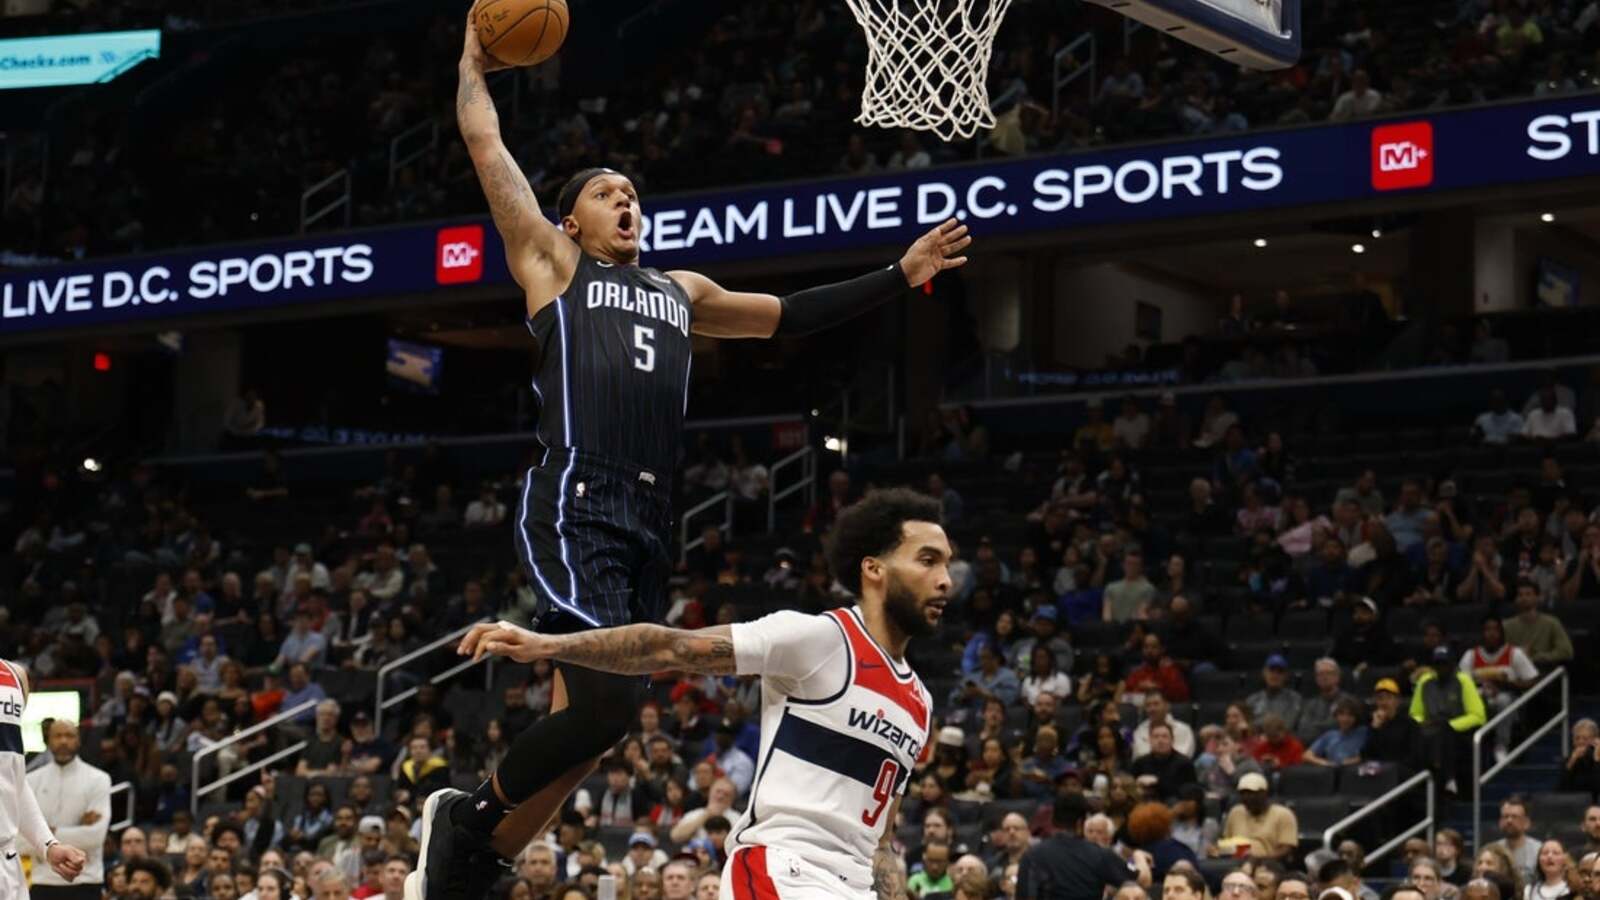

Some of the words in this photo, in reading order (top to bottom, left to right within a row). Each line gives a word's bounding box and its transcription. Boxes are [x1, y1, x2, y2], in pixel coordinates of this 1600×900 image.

[1527, 110, 1600, 160] ST
[783, 187, 902, 237] LIVE
[917, 176, 1018, 224] D.C.
[1033, 147, 1283, 212] SPORTS
[3, 274, 94, 318] LIVE
[102, 266, 179, 308] D.C.
[188, 244, 374, 299] SPORTS
[587, 281, 689, 337] ORLANDO
[634, 324, 655, 372] 5
[861, 758, 899, 828] 9
